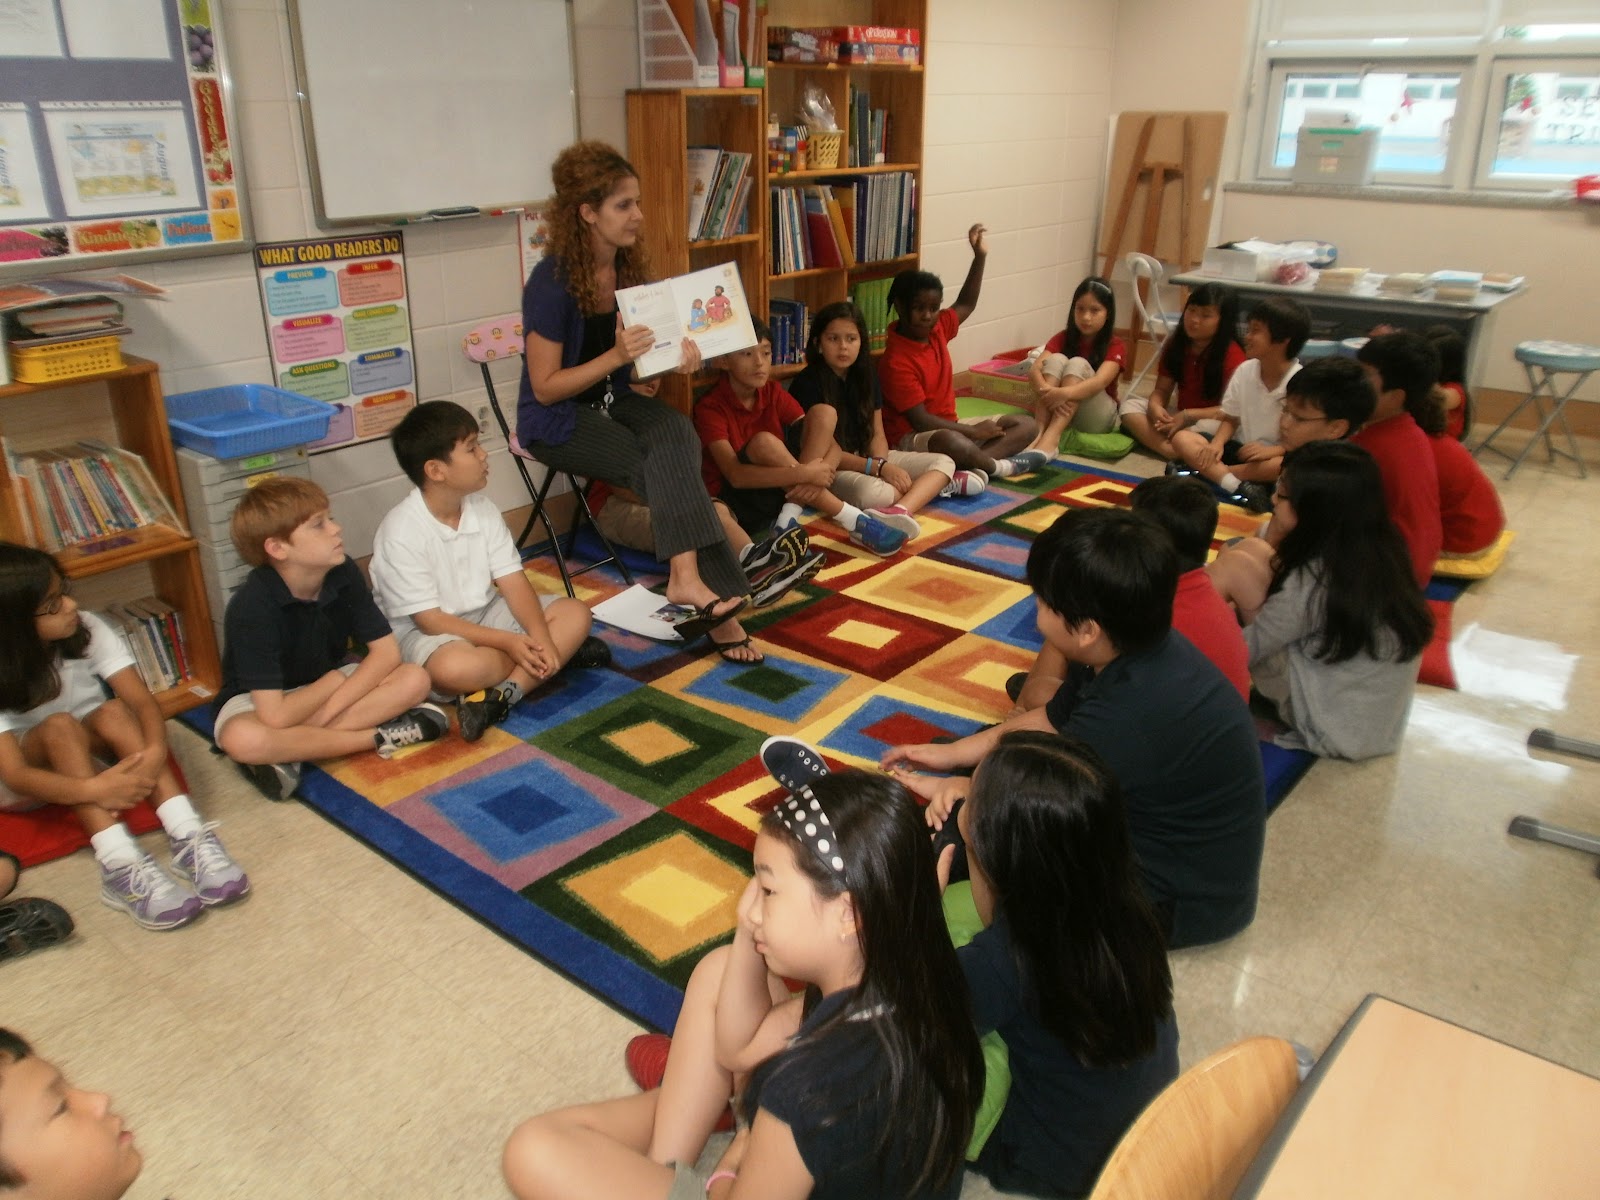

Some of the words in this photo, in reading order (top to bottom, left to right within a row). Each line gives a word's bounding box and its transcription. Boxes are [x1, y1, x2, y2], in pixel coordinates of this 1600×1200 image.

[865, 26, 898, 39] OPERATION
[77, 229, 146, 245] Kindness
[260, 247, 294, 265] WHAT
[298, 243, 332, 261] GOOD
[333, 239, 382, 258] READERS
[383, 237, 399, 252] DO
[287, 271, 314, 280] PREVIEW
[292, 317, 323, 328] VISUALIZE
[364, 351, 396, 361] SUMMARIZE
[292, 365, 304, 375] ASK
[304, 361, 336, 373] QUESTIONS
